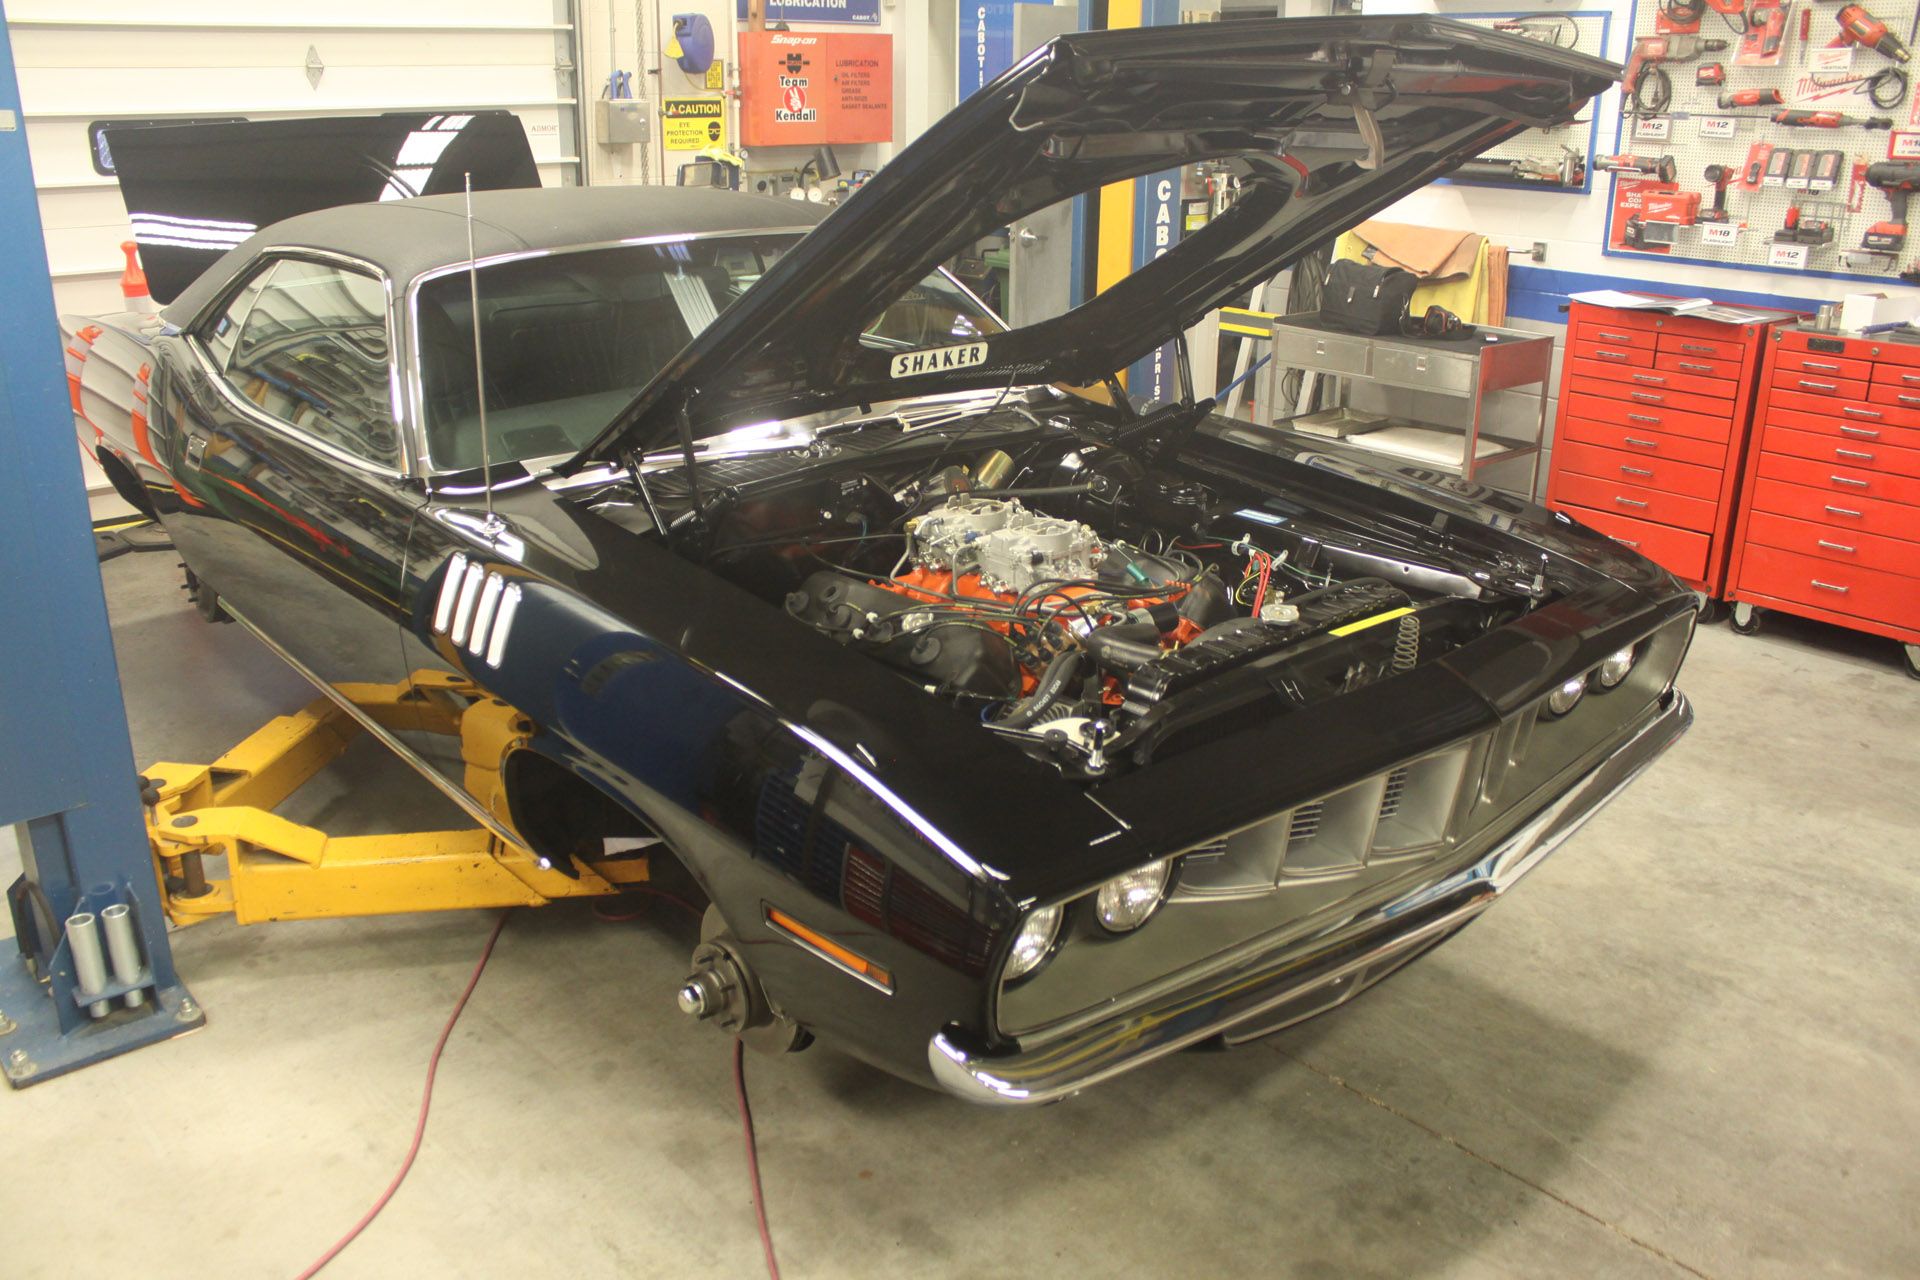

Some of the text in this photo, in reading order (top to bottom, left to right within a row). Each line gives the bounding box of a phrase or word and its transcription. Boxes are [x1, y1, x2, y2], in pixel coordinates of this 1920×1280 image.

[771, 34, 817, 46] Snap-on
[780, 76, 808, 87] Team
[678, 104, 720, 114] CAUTION
[776, 109, 816, 121] Kendall
[1642, 122, 1663, 130] M12
[1707, 120, 1729, 129] M12
[1709, 228, 1730, 237] M18
[1776, 250, 1799, 259] M12
[898, 347, 980, 374] SHAKER
